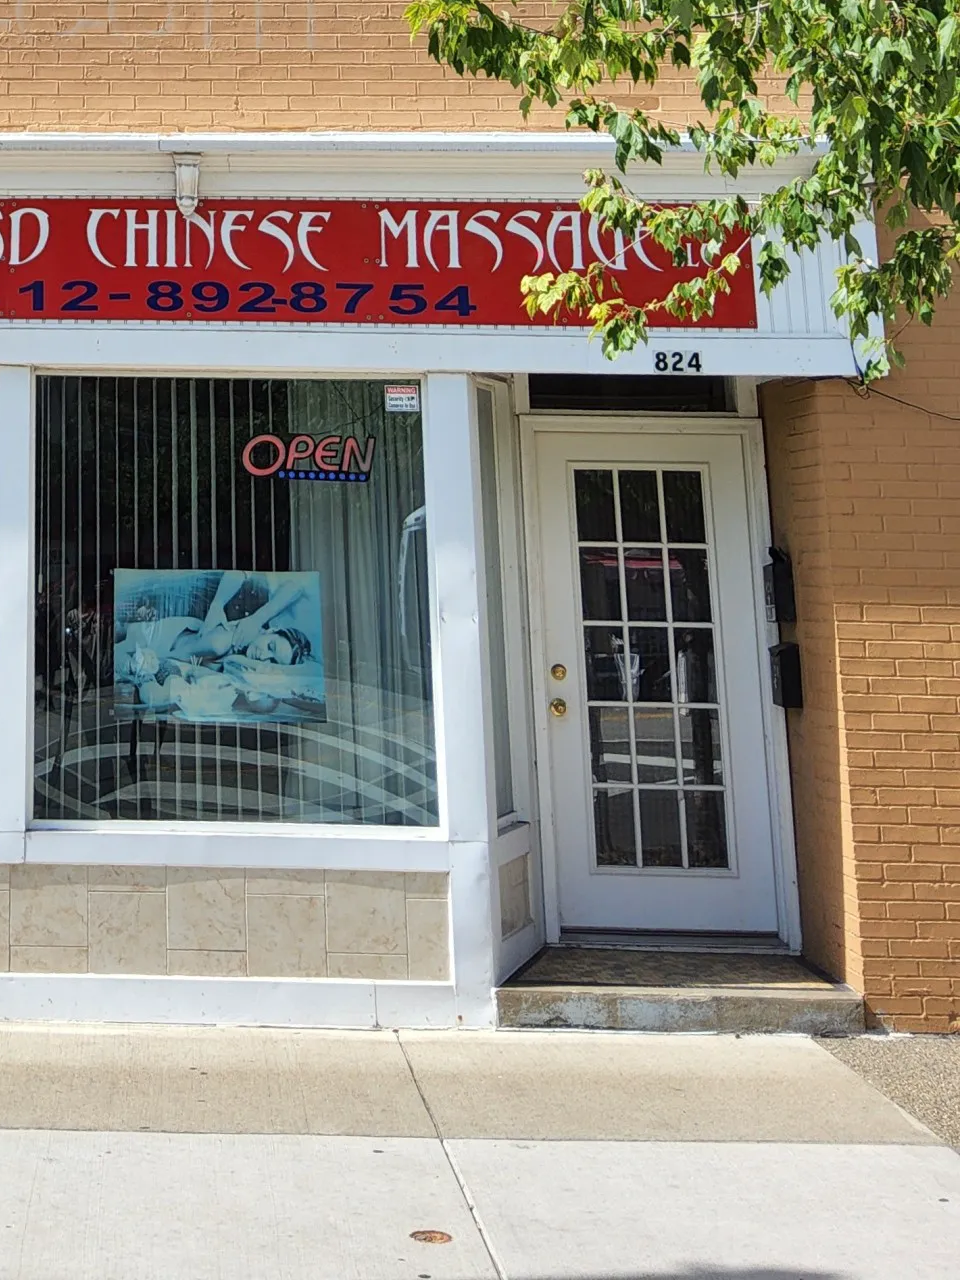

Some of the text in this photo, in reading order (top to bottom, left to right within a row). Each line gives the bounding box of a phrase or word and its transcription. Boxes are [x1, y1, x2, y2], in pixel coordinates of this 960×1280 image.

[86, 208, 332, 272] CHINESE
[655, 352, 702, 372] 824
[242, 434, 376, 476] OPEN
